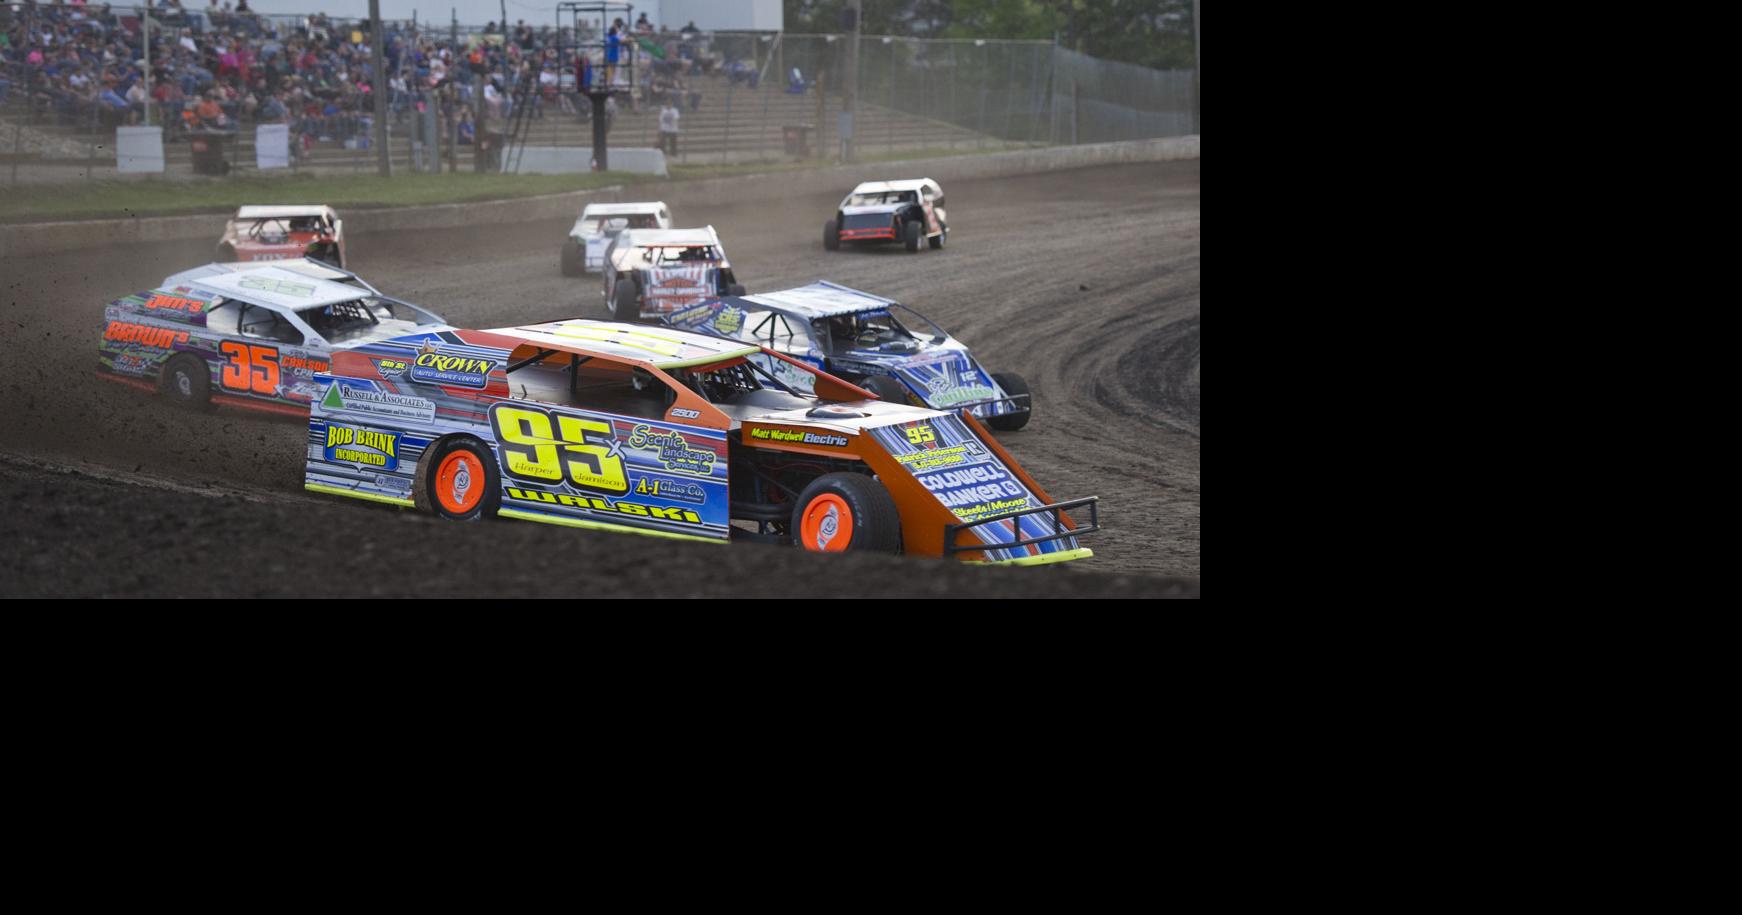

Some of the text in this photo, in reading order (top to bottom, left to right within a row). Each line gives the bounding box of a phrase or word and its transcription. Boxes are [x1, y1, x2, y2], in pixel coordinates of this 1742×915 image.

[220, 342, 279, 395] 35
[416, 352, 495, 375] CROWN
[343, 387, 373, 400] RUSSELL
[374, 394, 380, 402] &
[380, 392, 425, 408] ASSOCIATES
[327, 426, 397, 457] BOB BRINK
[630, 425, 683, 450] Scenic
[751, 428, 848, 446] Matt Wardwell Electric
[905, 425, 936, 445] 95
[335, 448, 386, 466] INCORPORATED
[495, 406, 628, 492] 95
[660, 443, 713, 466] Landscape
[514, 461, 556, 476] Harper
[918, 465, 1006, 491] COLDWELL
[660, 481, 685, 494] Glass
[687, 484, 704, 497] Co.
[933, 483, 1004, 507] BANKER
[506, 487, 702, 524] WALSKI
